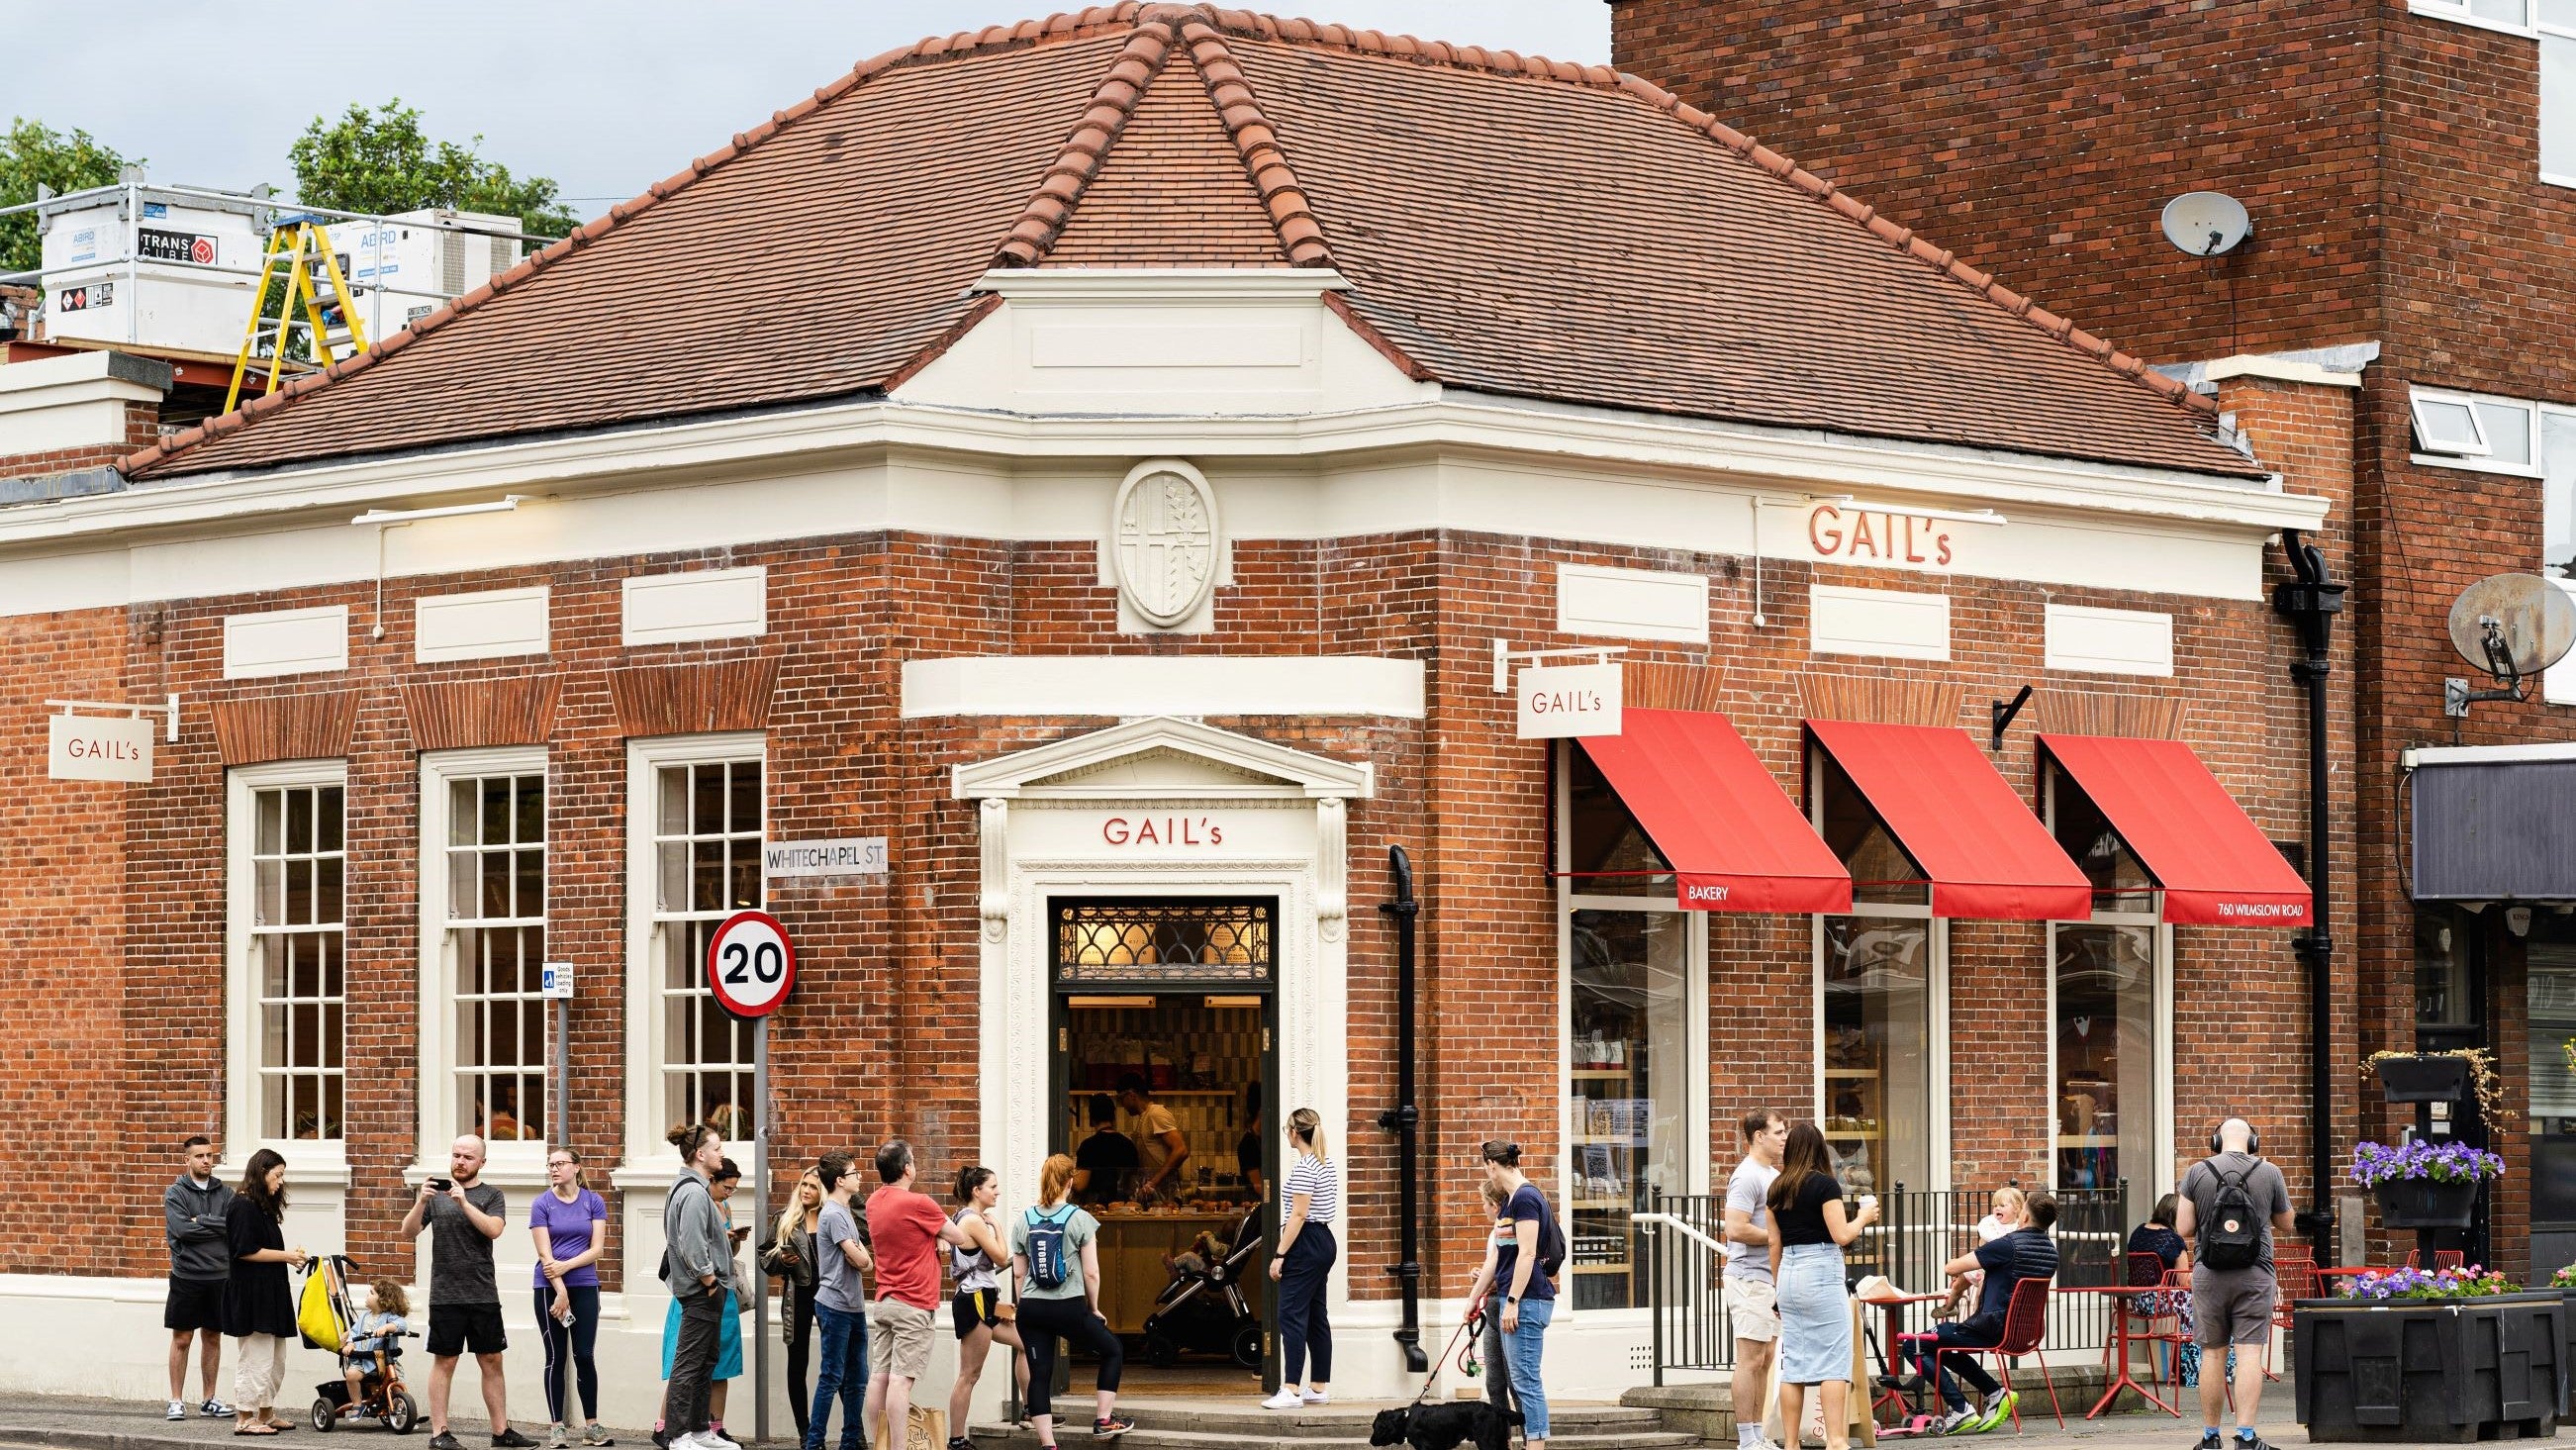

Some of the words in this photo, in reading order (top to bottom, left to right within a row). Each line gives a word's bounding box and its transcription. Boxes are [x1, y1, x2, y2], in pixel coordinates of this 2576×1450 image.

[143, 235, 189, 250] TRANS
[361, 231, 396, 247] ABRD
[142, 247, 188, 261] CUBE
[1809, 505, 1952, 565] GAIL's
[1532, 690, 1601, 714] GAIL's
[68, 738, 139, 760] GAIL's
[1103, 817, 1222, 845] GAIL's
[767, 846, 860, 869] WHITECHAPEL
[865, 845, 885, 865] ST.
[1688, 885, 1729, 901] BAKERY
[2218, 903, 2234, 916] 760
[2236, 904, 2280, 917] WILMSLOW
[2282, 905, 2303, 917] ROAD
[723, 941, 783, 984] 20
[1037, 1240, 1049, 1279] UTOBEST
